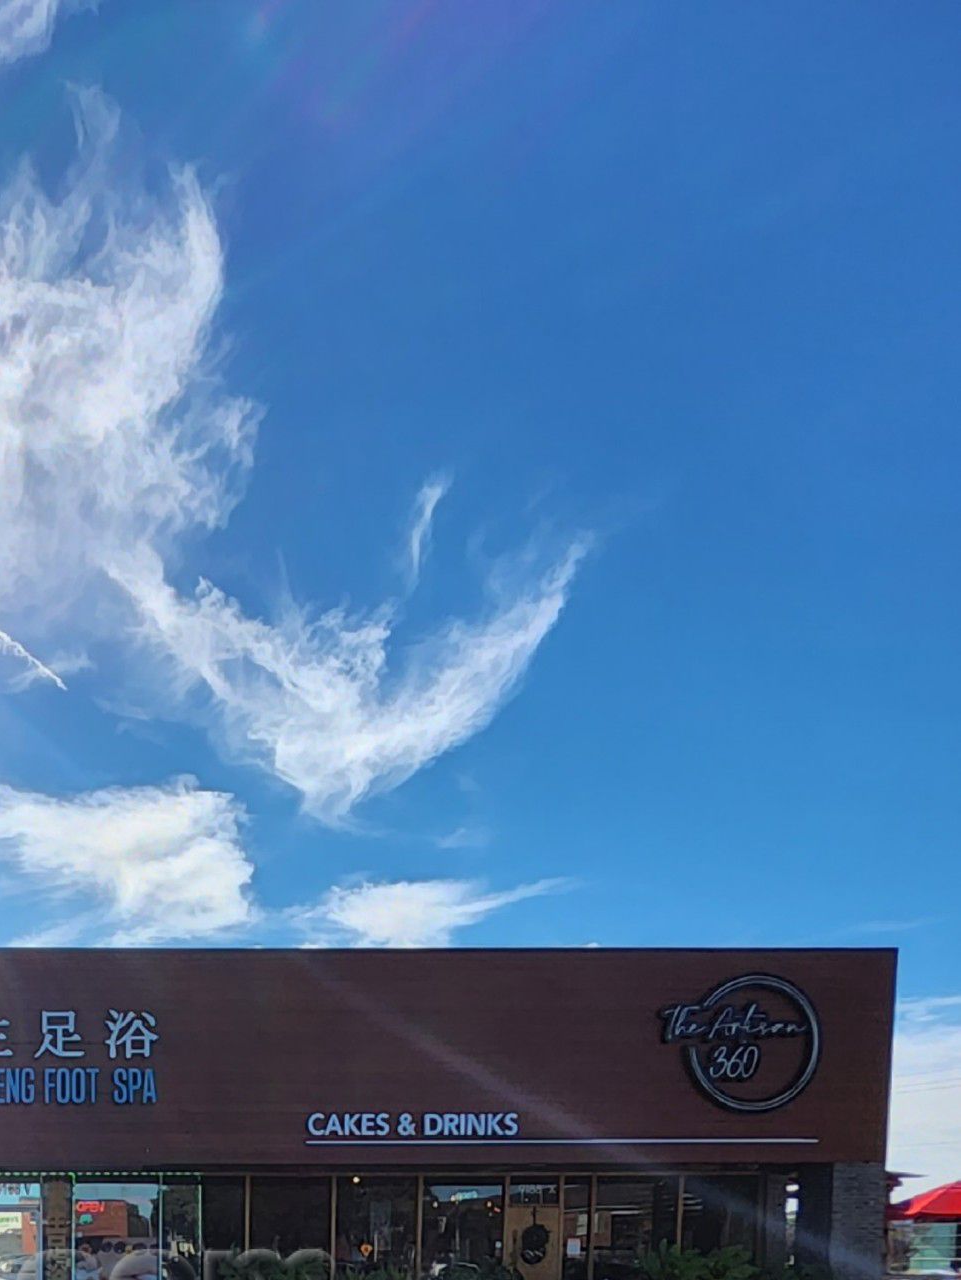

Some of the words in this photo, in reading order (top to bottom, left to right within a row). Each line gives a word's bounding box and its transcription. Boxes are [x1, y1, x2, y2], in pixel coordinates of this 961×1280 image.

[664, 1004, 706, 1039] The
[709, 1045, 759, 1078] 360
[43, 1067, 100, 1104] FOOT
[112, 1067, 158, 1104] SPA
[307, 1112, 390, 1136] CAKES
[396, 1112, 417, 1136] &
[423, 1112, 519, 1136] DRINKS
